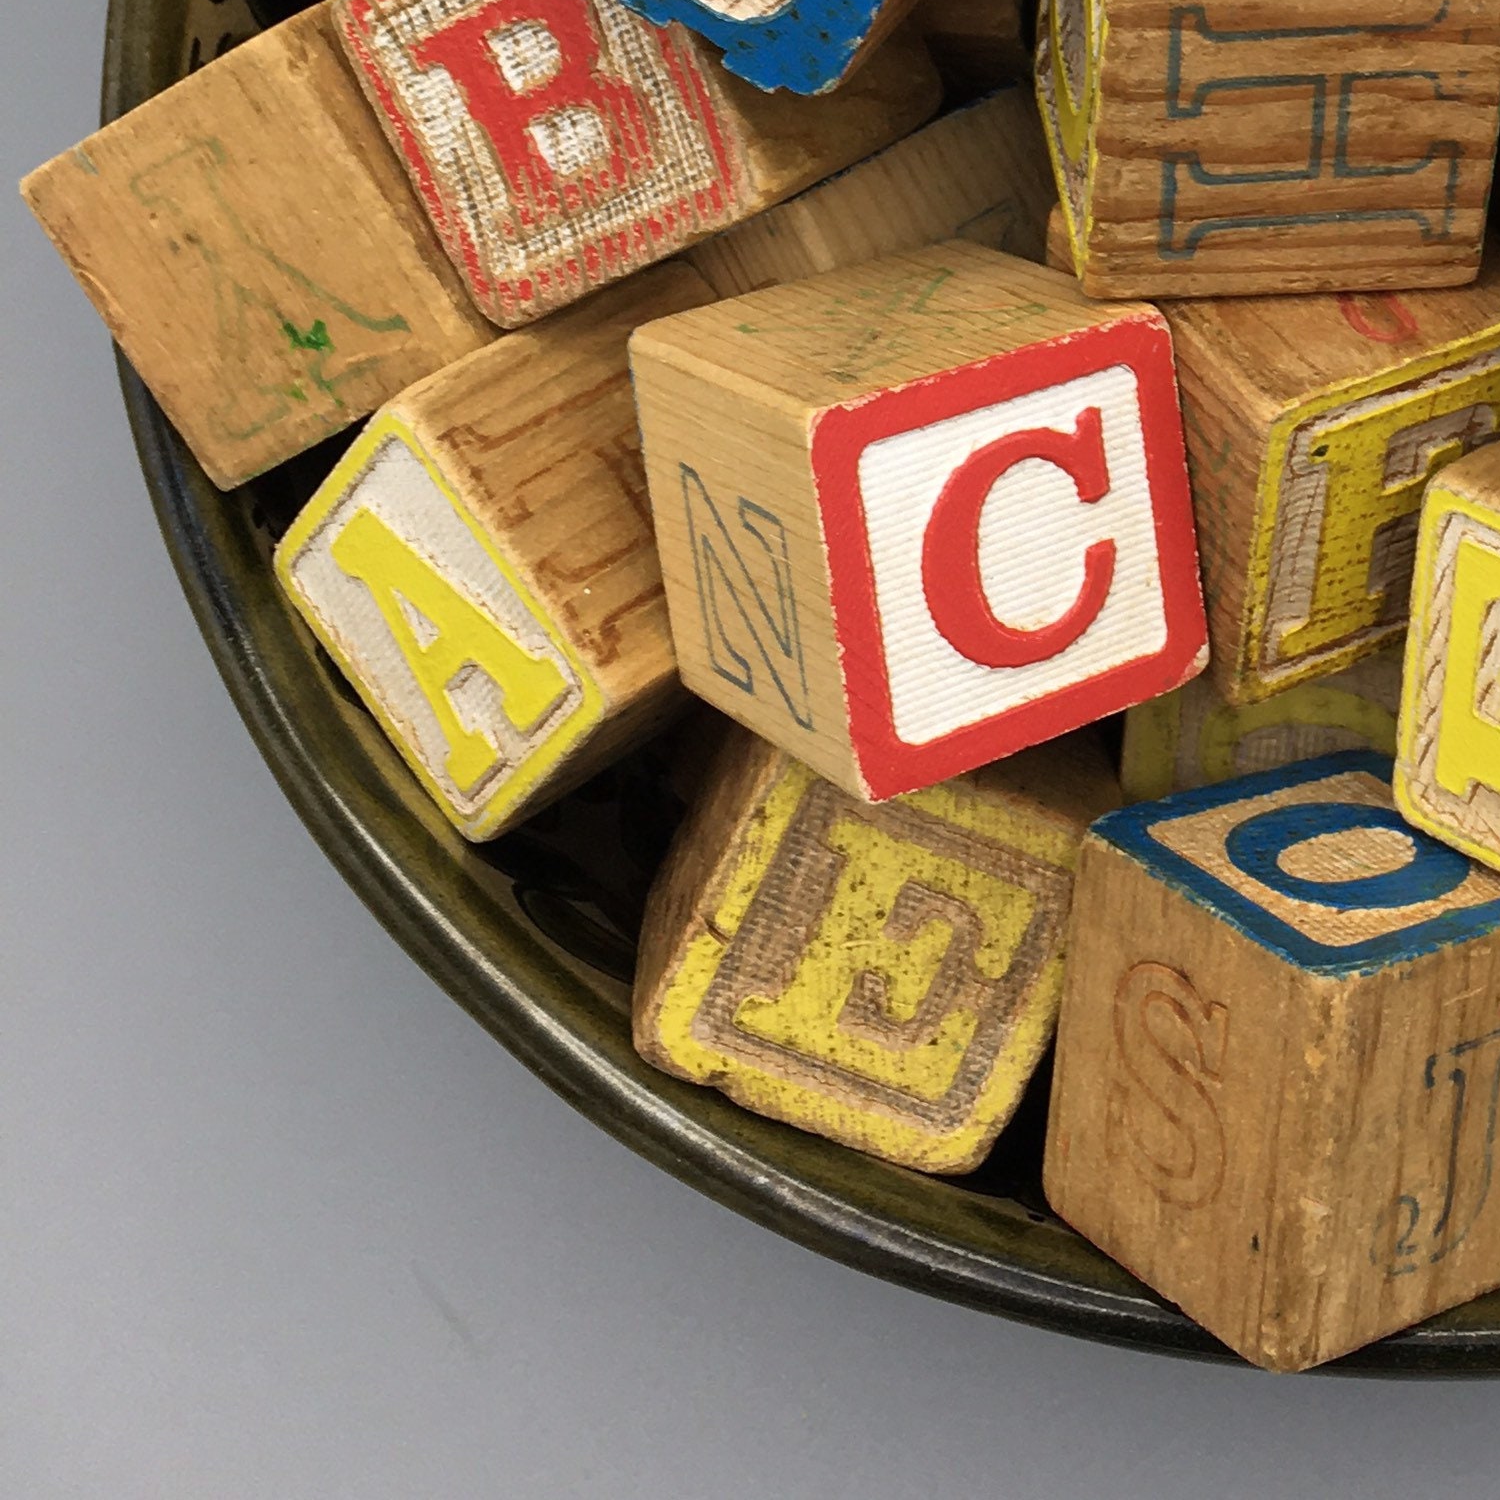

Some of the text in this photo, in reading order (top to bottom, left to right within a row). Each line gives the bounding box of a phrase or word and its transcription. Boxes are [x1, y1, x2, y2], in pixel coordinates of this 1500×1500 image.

[329, 507, 575, 794] A
[921, 405, 1117, 670] C
[734, 817, 1038, 1100] E
[1225, 802, 1471, 910] O
[1105, 959, 1232, 1211] S
